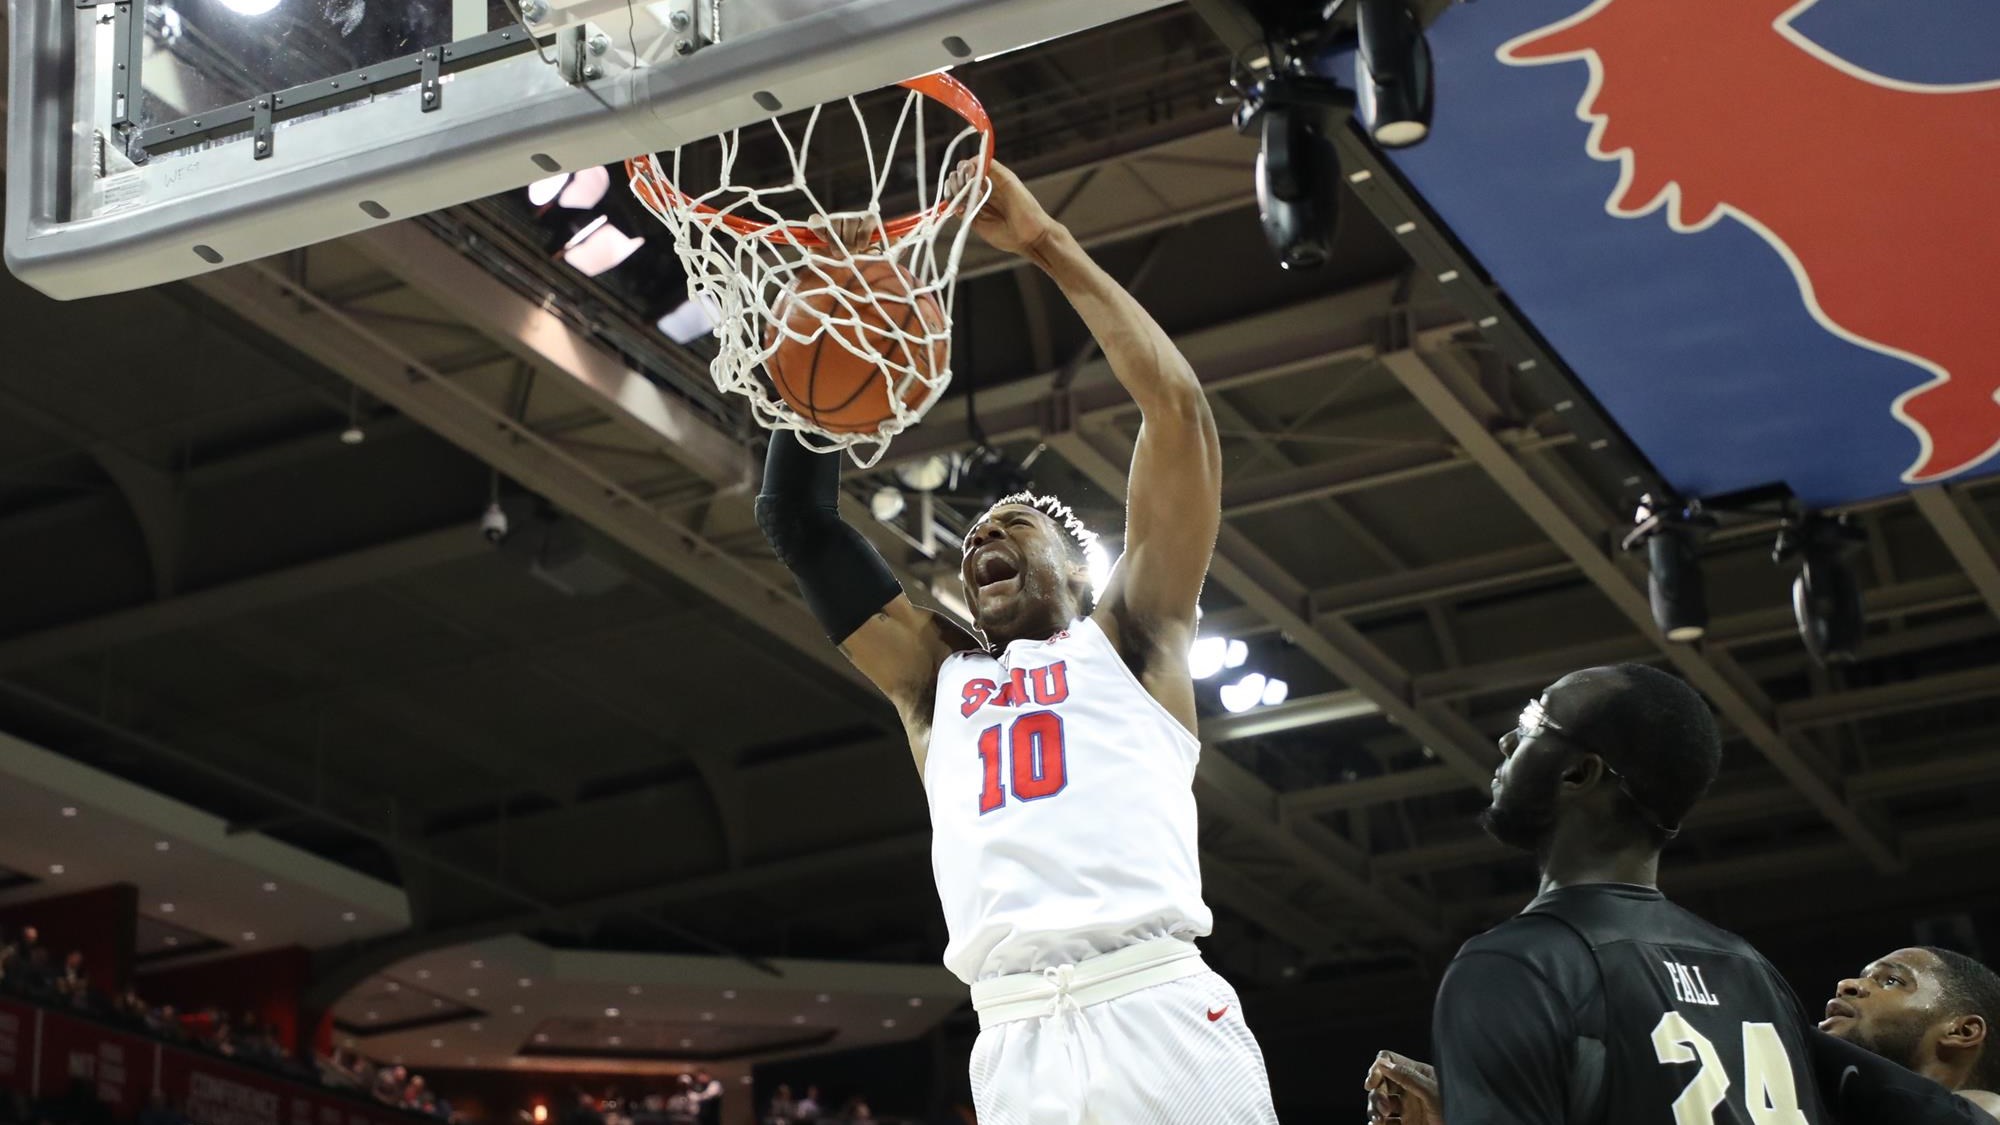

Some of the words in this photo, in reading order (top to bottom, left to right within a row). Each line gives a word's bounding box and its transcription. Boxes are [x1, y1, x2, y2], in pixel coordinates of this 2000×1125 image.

[960, 660, 1070, 719] SMU
[977, 709, 1068, 816] 10
[1663, 960, 1720, 1006] FALL
[1651, 1011, 1810, 1125] 24
